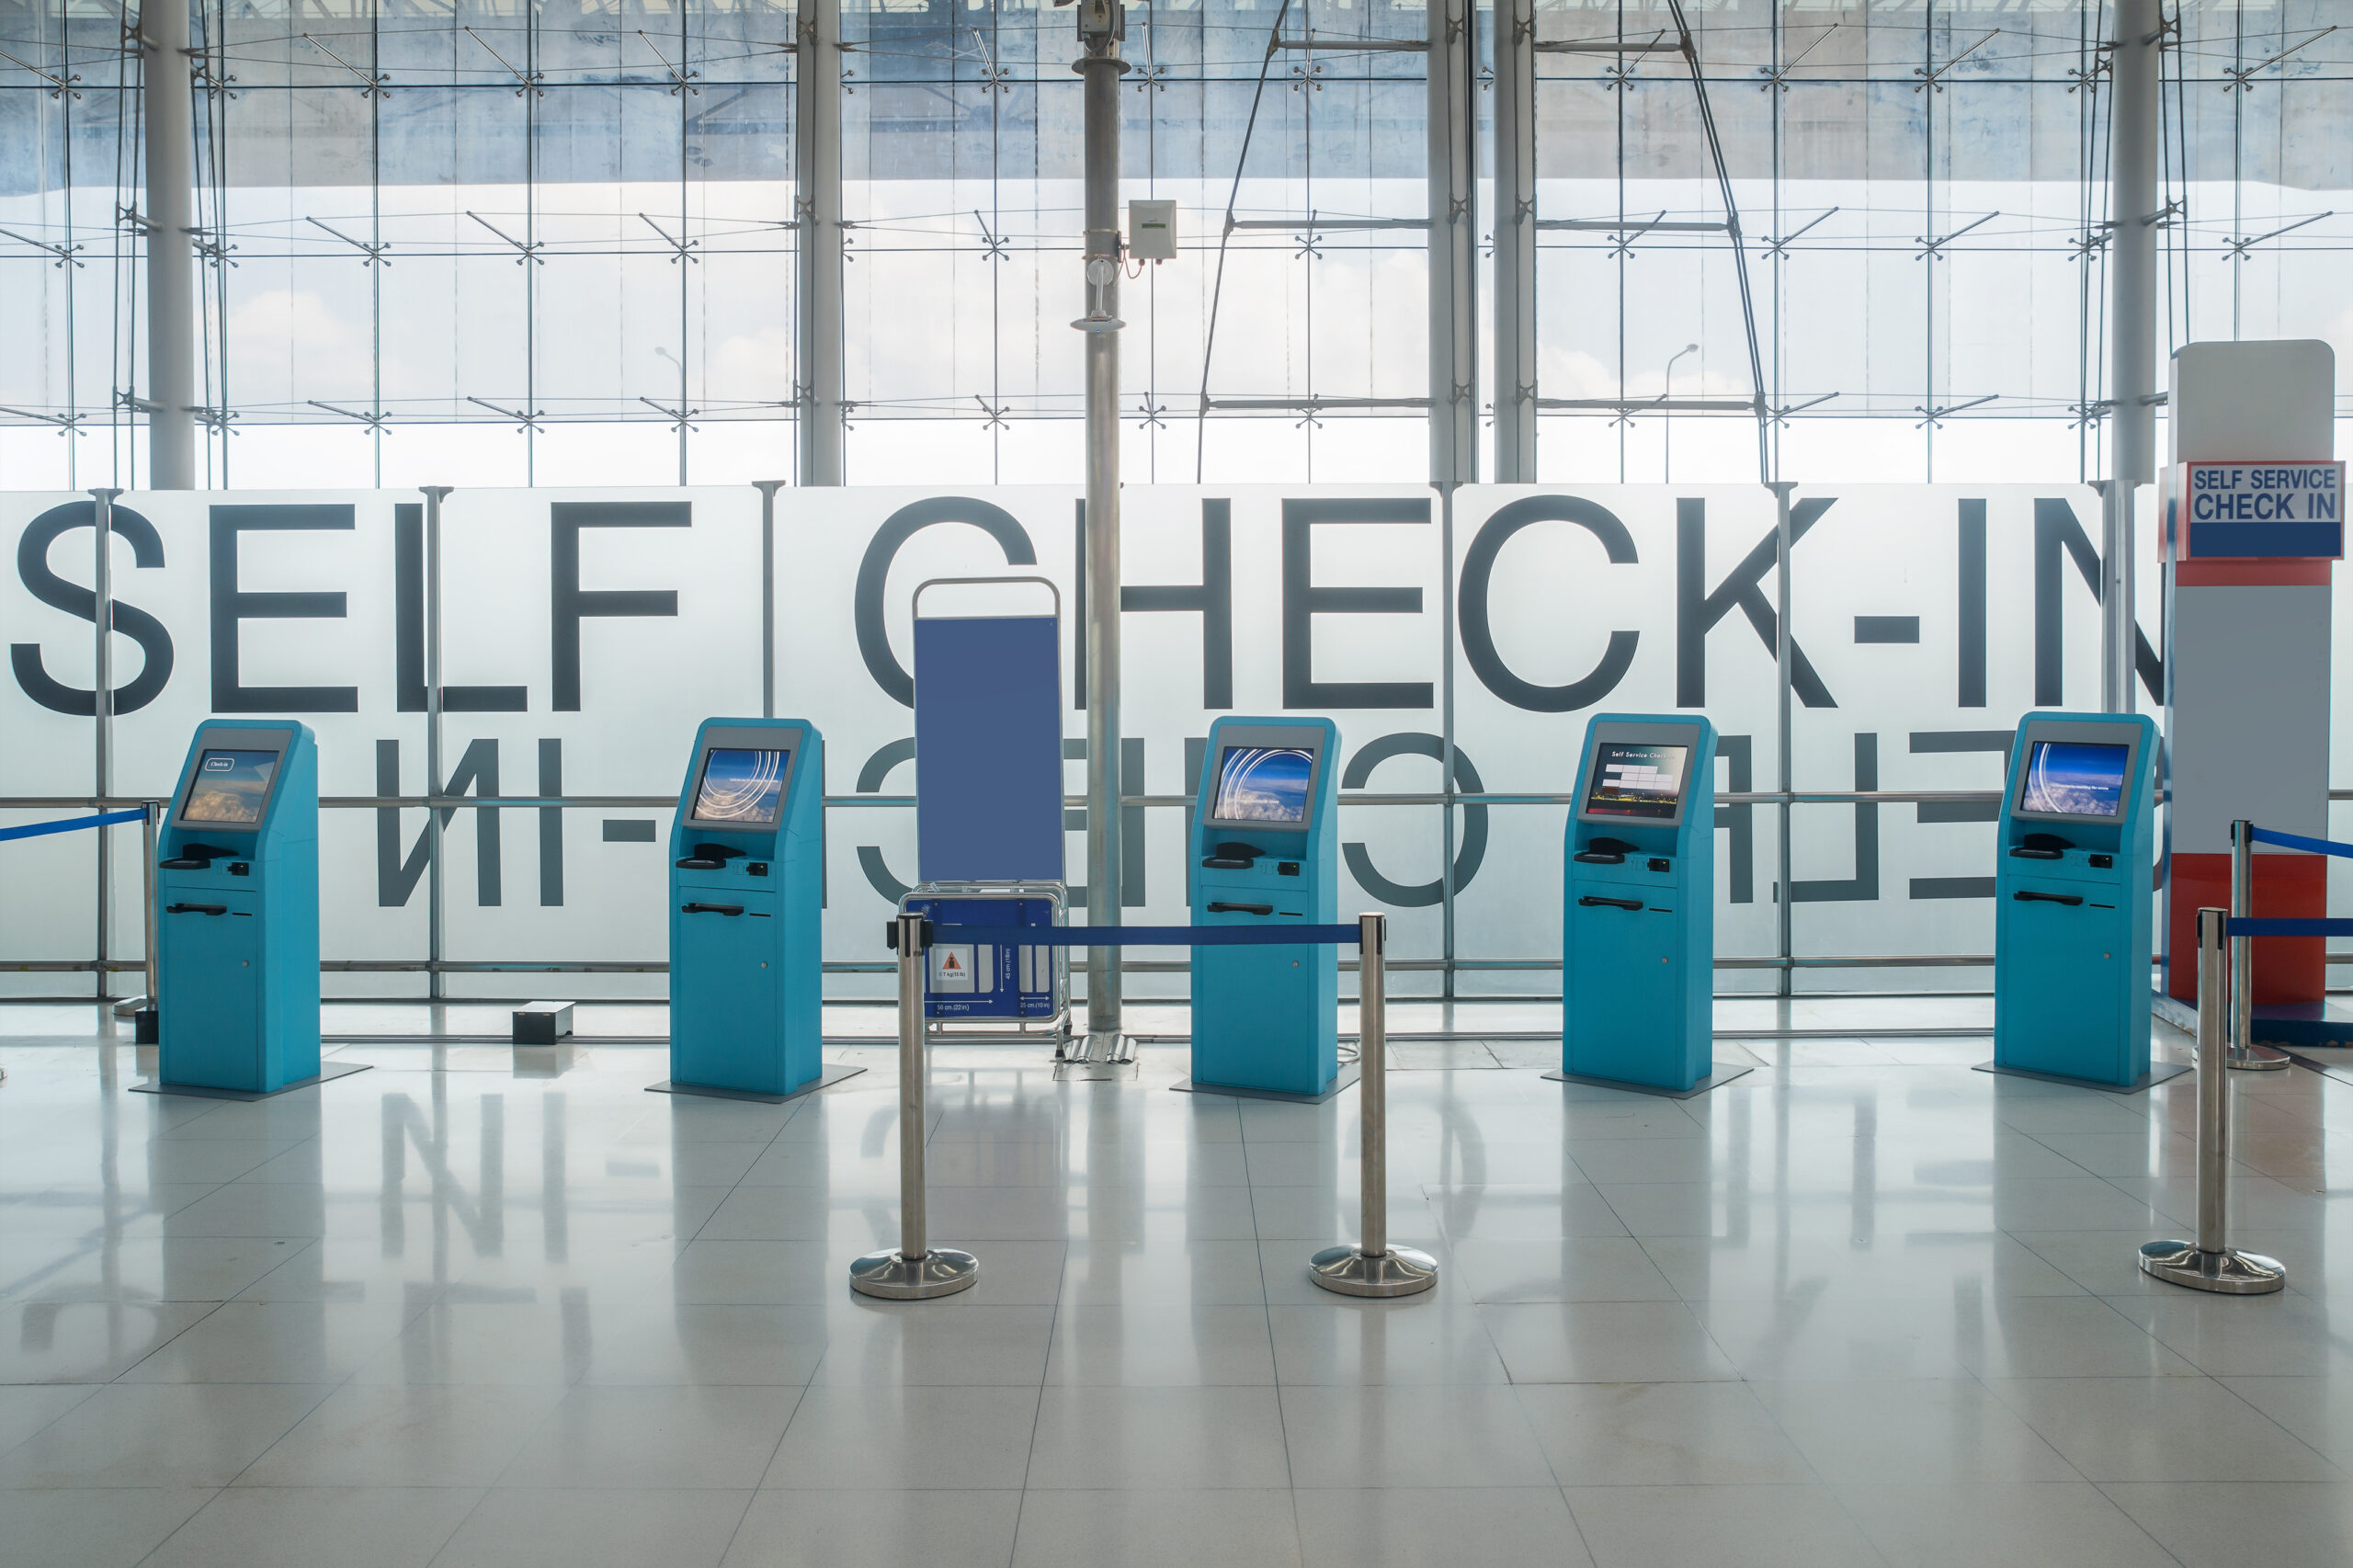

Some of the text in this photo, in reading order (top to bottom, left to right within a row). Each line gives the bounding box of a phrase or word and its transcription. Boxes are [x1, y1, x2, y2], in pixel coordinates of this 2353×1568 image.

[2194, 469, 2336, 490] SELF SERVICE
[2194, 493, 2336, 520] CHECK IN
[10, 494, 2165, 716] SELF CHECK-IN
